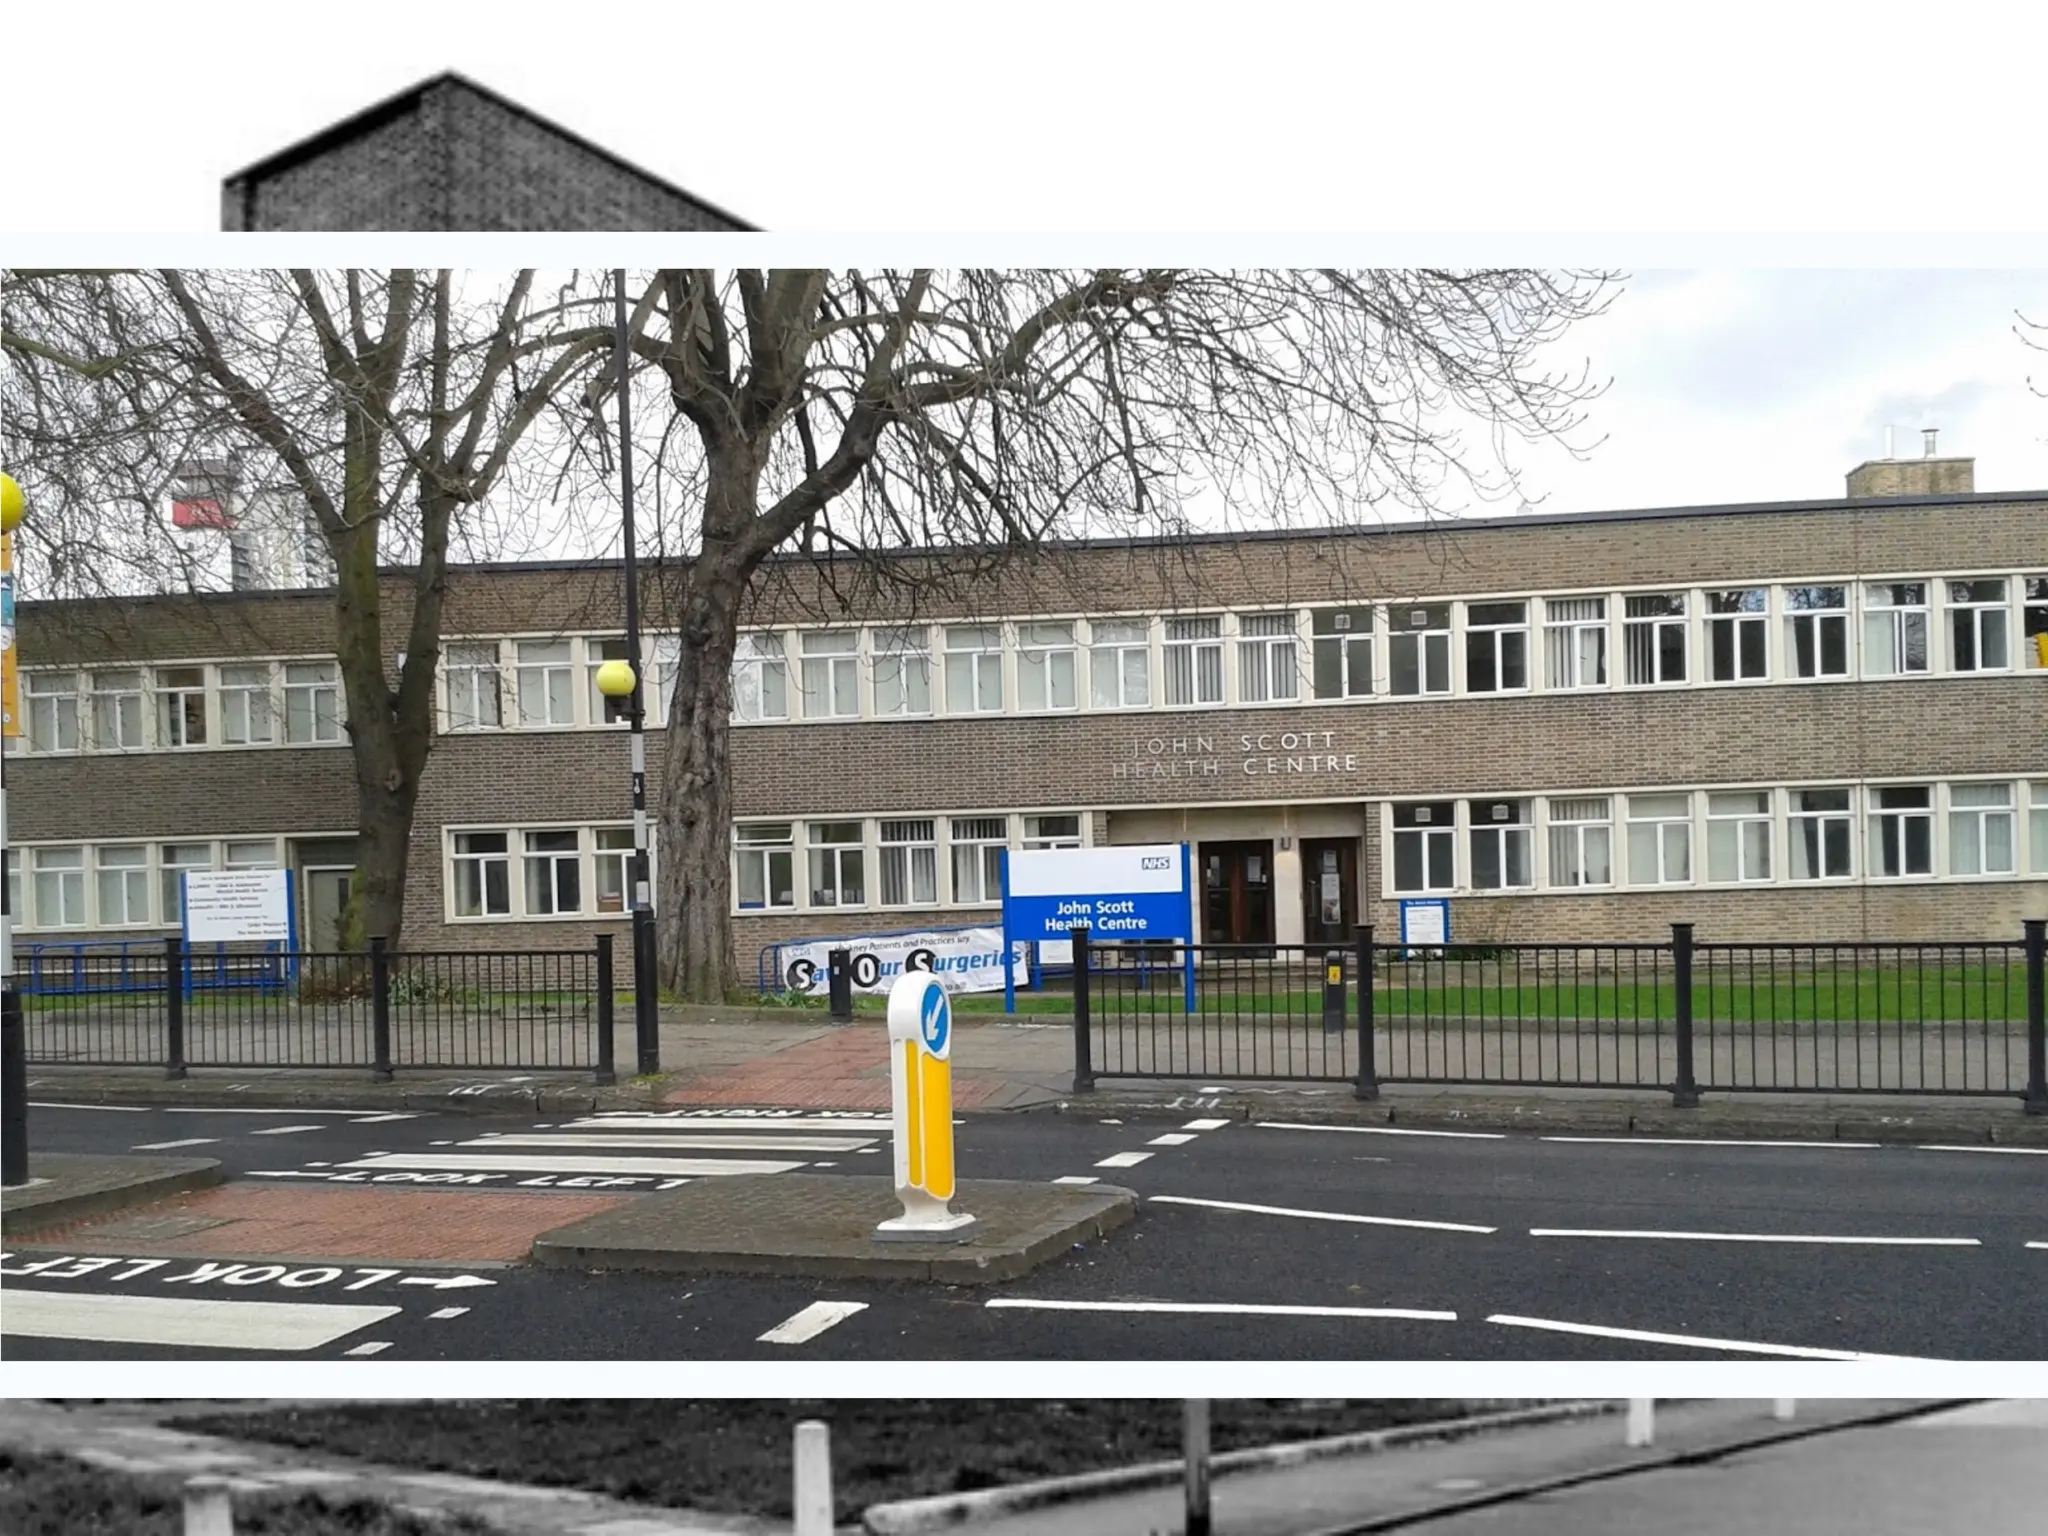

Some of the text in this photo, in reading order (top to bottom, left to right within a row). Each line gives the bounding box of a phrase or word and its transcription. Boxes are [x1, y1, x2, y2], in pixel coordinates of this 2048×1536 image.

[1131, 731, 1336, 758] JOHN SCOTT
[1112, 754, 1358, 779] HEALTH CENTRE
[1142, 857, 1170, 870] NHS
[1057, 900, 1135, 915] John Scott
[1045, 917, 1147, 931] Health Centre
[869, 941, 901, 950] Patients
[903, 939, 919, 948] and
[920, 937, 955, 946] Practices
[857, 957, 903, 984] Our
[327, 1171, 693, 1190] LOOK LEFT
[163, 1262, 403, 1291] LOOK
